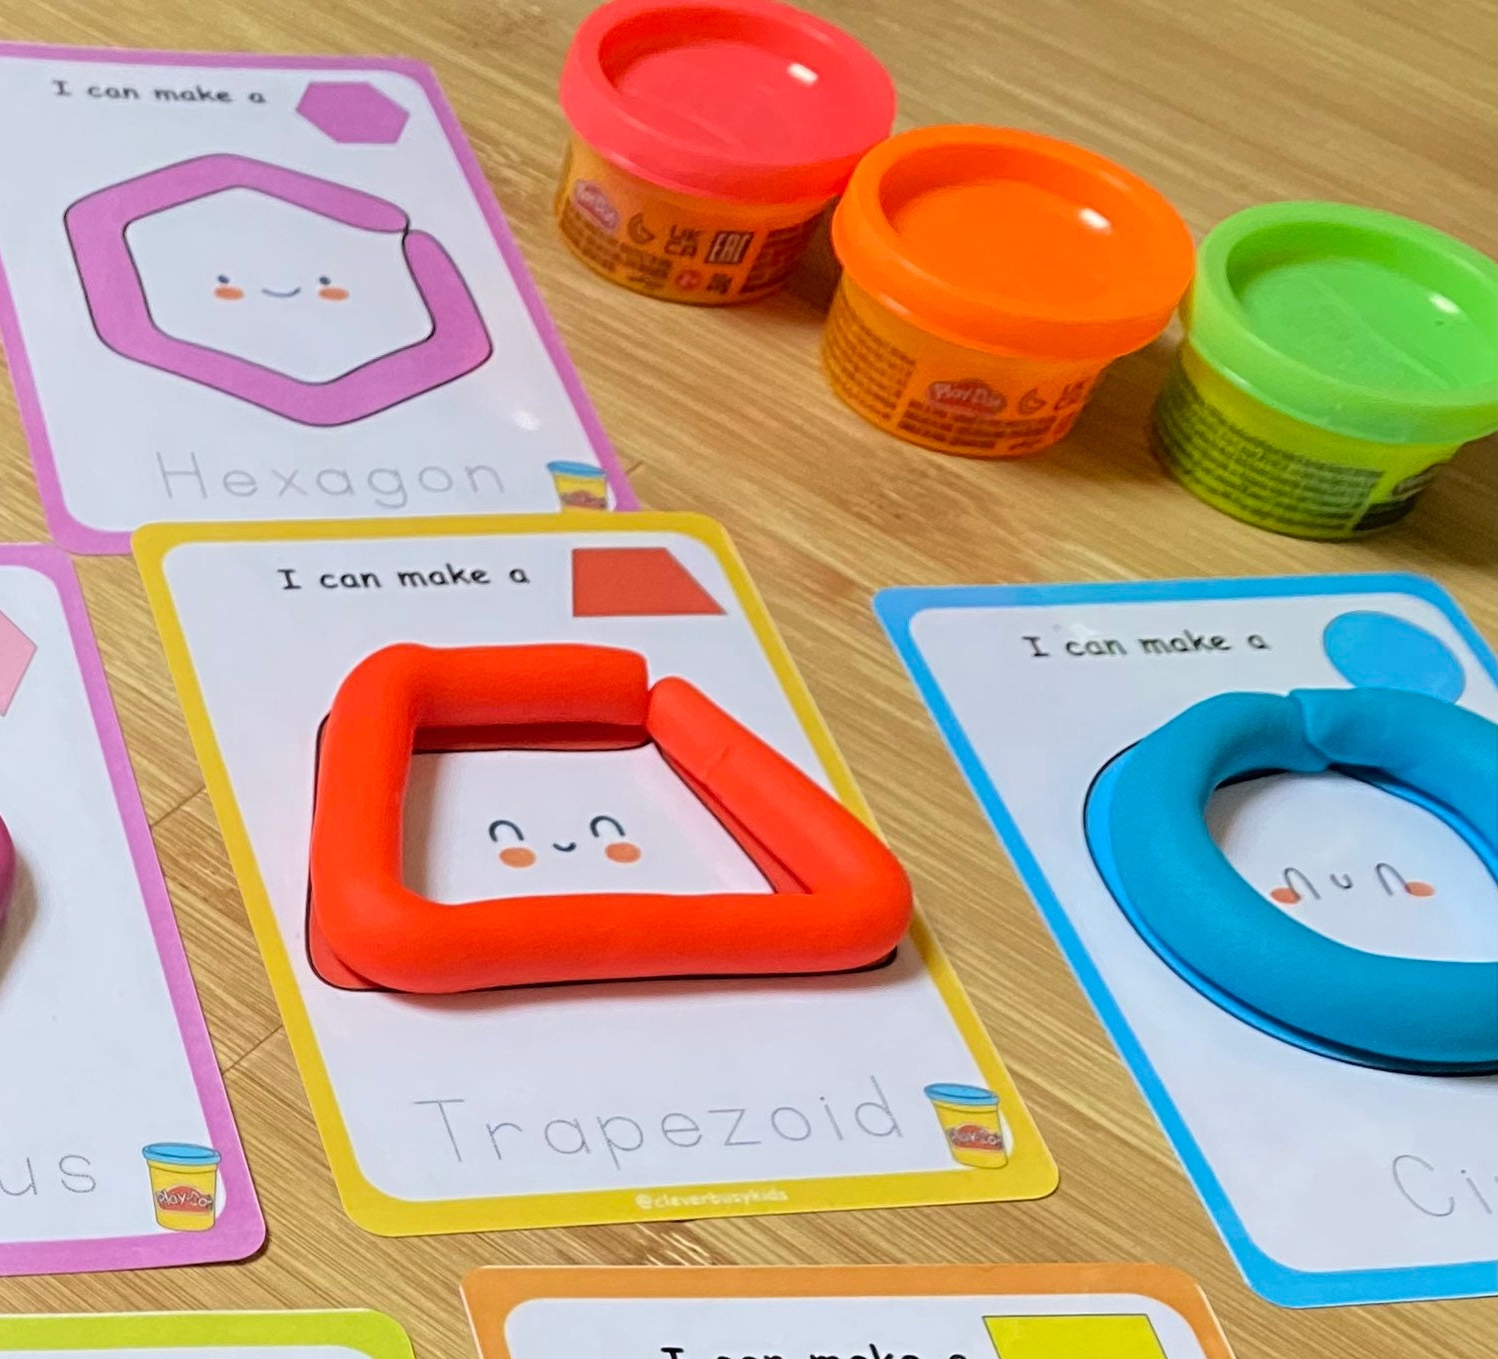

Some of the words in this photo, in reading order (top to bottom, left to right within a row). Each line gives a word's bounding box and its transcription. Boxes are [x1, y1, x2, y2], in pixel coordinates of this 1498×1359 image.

[52, 79, 72, 97] I
[86, 85, 141, 100] can
[153, 84, 233, 104] make
[247, 92, 267, 105] a
[155, 451, 505, 510] Hexagon
[276, 568, 302, 591] I
[319, 572, 382, 590] can
[396, 562, 491, 588] make
[508, 568, 531, 585] a
[1021, 635, 1050, 659] I
[1064, 639, 1128, 657] can
[1137, 629, 1232, 655] make
[1246, 634, 1270, 650] a
[412, 1076, 905, 1168] Trapezoid
[633, 1189, 790, 1211] @cleverbusykids
[1391, 1154, 1498, 1218] Ci
